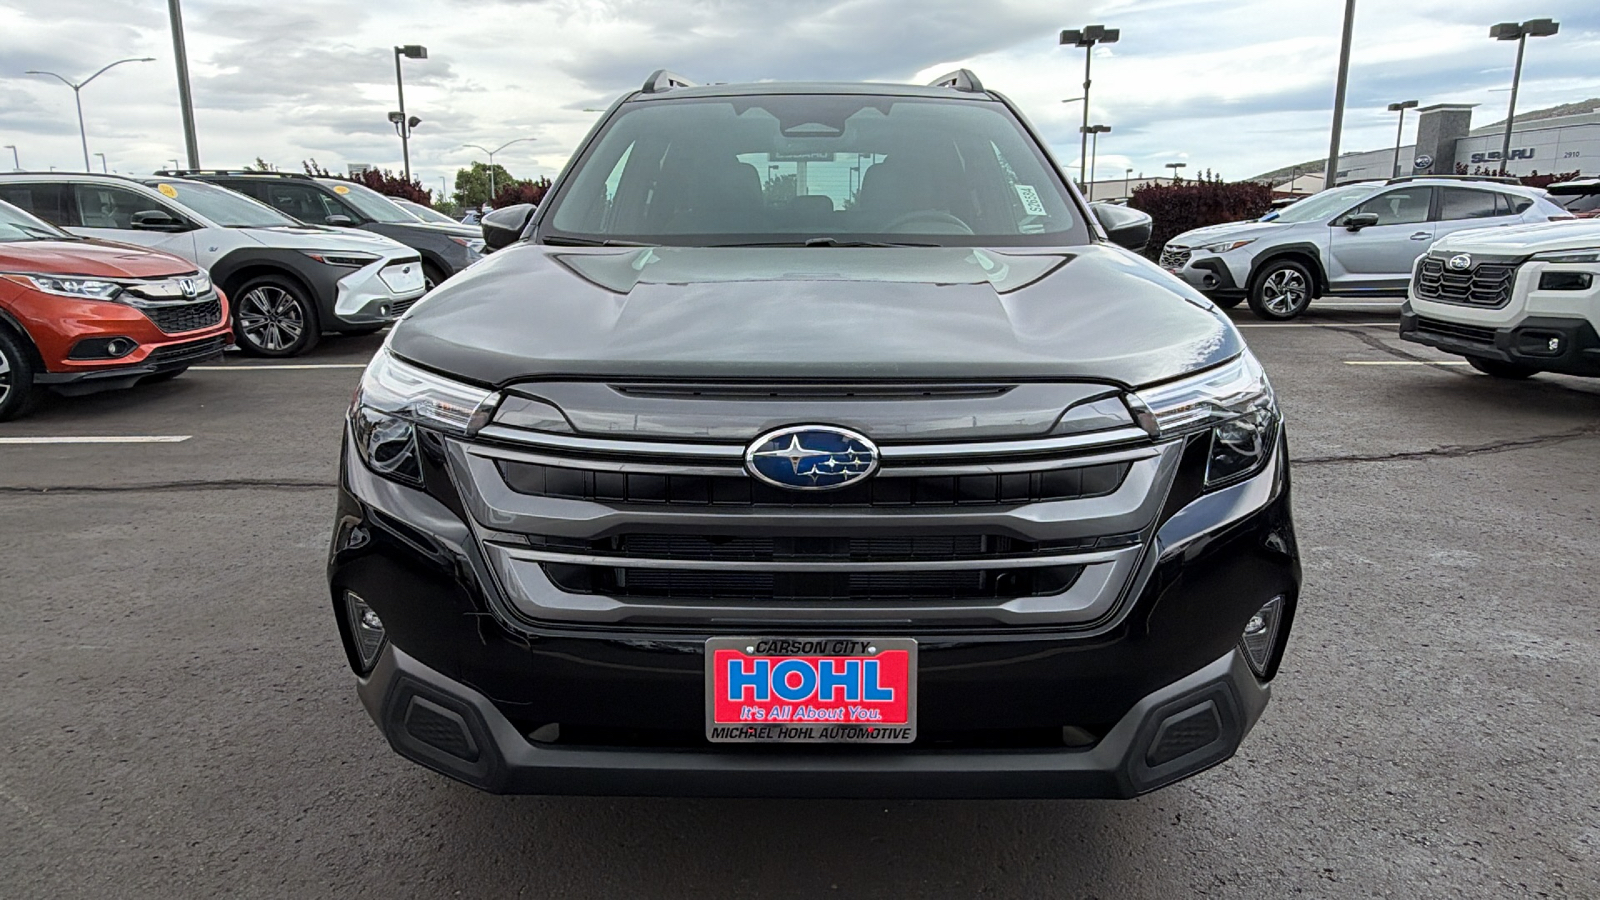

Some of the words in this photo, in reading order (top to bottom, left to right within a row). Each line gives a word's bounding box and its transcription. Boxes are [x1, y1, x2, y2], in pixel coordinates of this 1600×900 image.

[756, 641, 828, 654] CARSON
[833, 641, 871, 654] CITY
[728, 659, 894, 702] HOHL
[740, 705, 764, 719] It's
[768, 705, 791, 719] All
[793, 705, 844, 719] About
[849, 705, 882, 719] You.
[711, 727, 773, 739] MICHAEL
[778, 727, 814, 739] HOHL
[820, 727, 911, 739] AUTOMOTIVE
